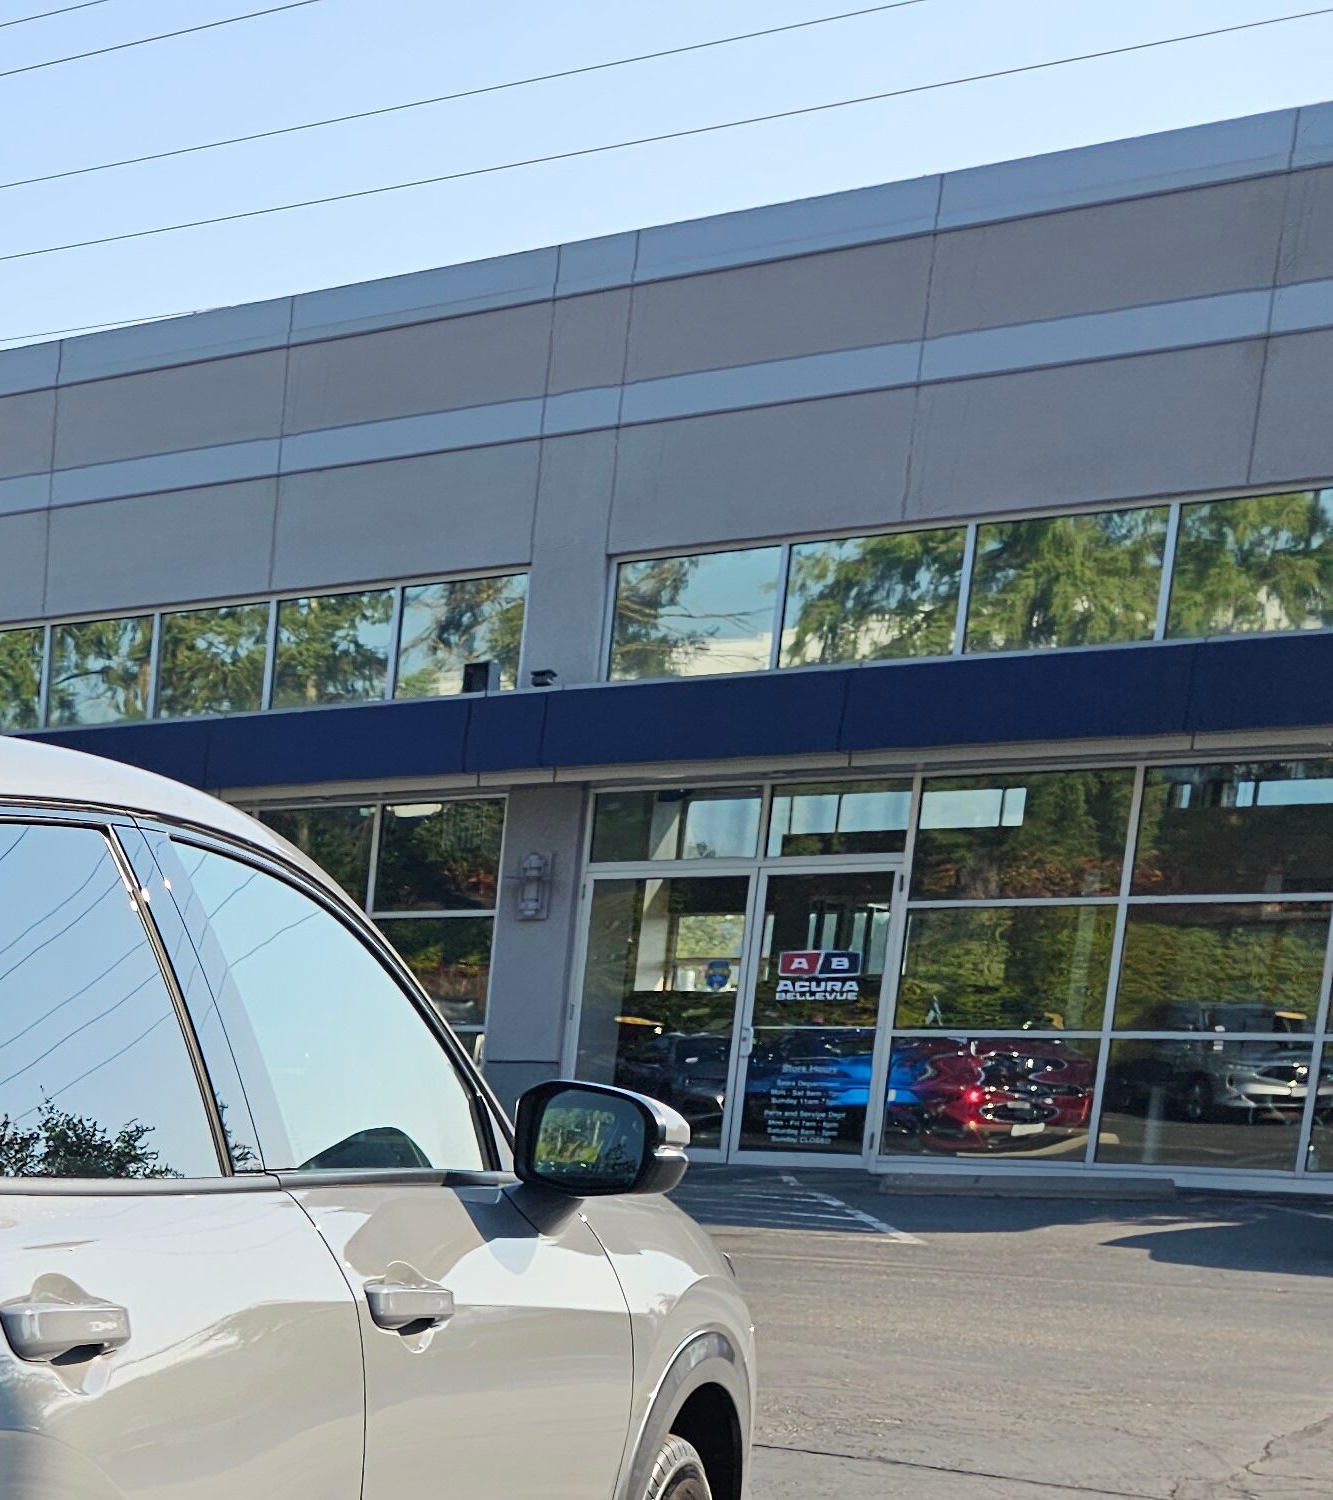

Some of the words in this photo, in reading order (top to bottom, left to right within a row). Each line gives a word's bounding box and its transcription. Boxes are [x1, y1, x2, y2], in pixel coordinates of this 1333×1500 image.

[789, 957, 809, 970] A
[830, 957, 850, 970] B
[776, 980, 859, 992] ACURA
[775, 992, 858, 1001] BELLEVUE
